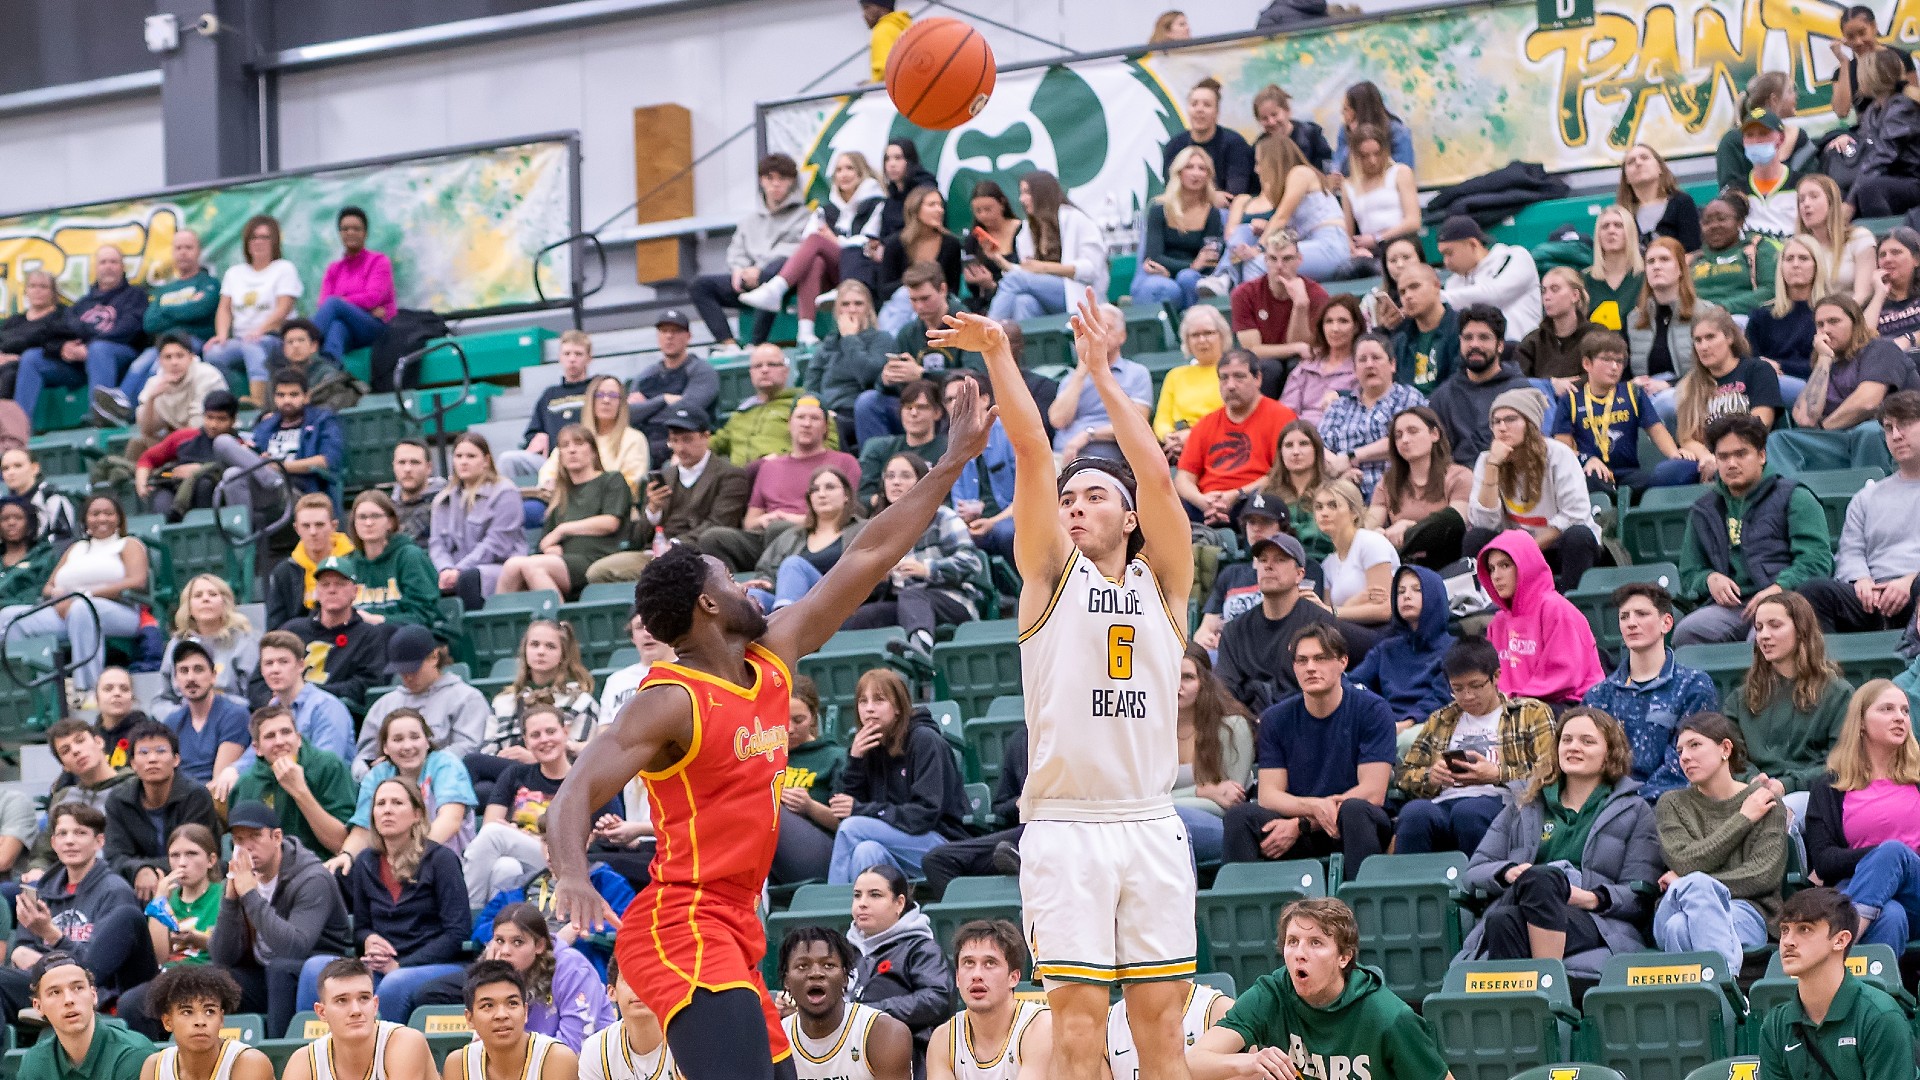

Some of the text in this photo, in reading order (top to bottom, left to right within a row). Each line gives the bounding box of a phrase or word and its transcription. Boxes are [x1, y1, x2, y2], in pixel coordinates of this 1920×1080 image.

[1088, 587, 1144, 615] GOLDE
[1107, 623, 1136, 680] 6
[1092, 689, 1147, 719] BEARS
[1471, 979, 1533, 990] RESERVED
[1632, 973, 1697, 985] RESERVED
[430, 1023, 467, 1031] RESERV
